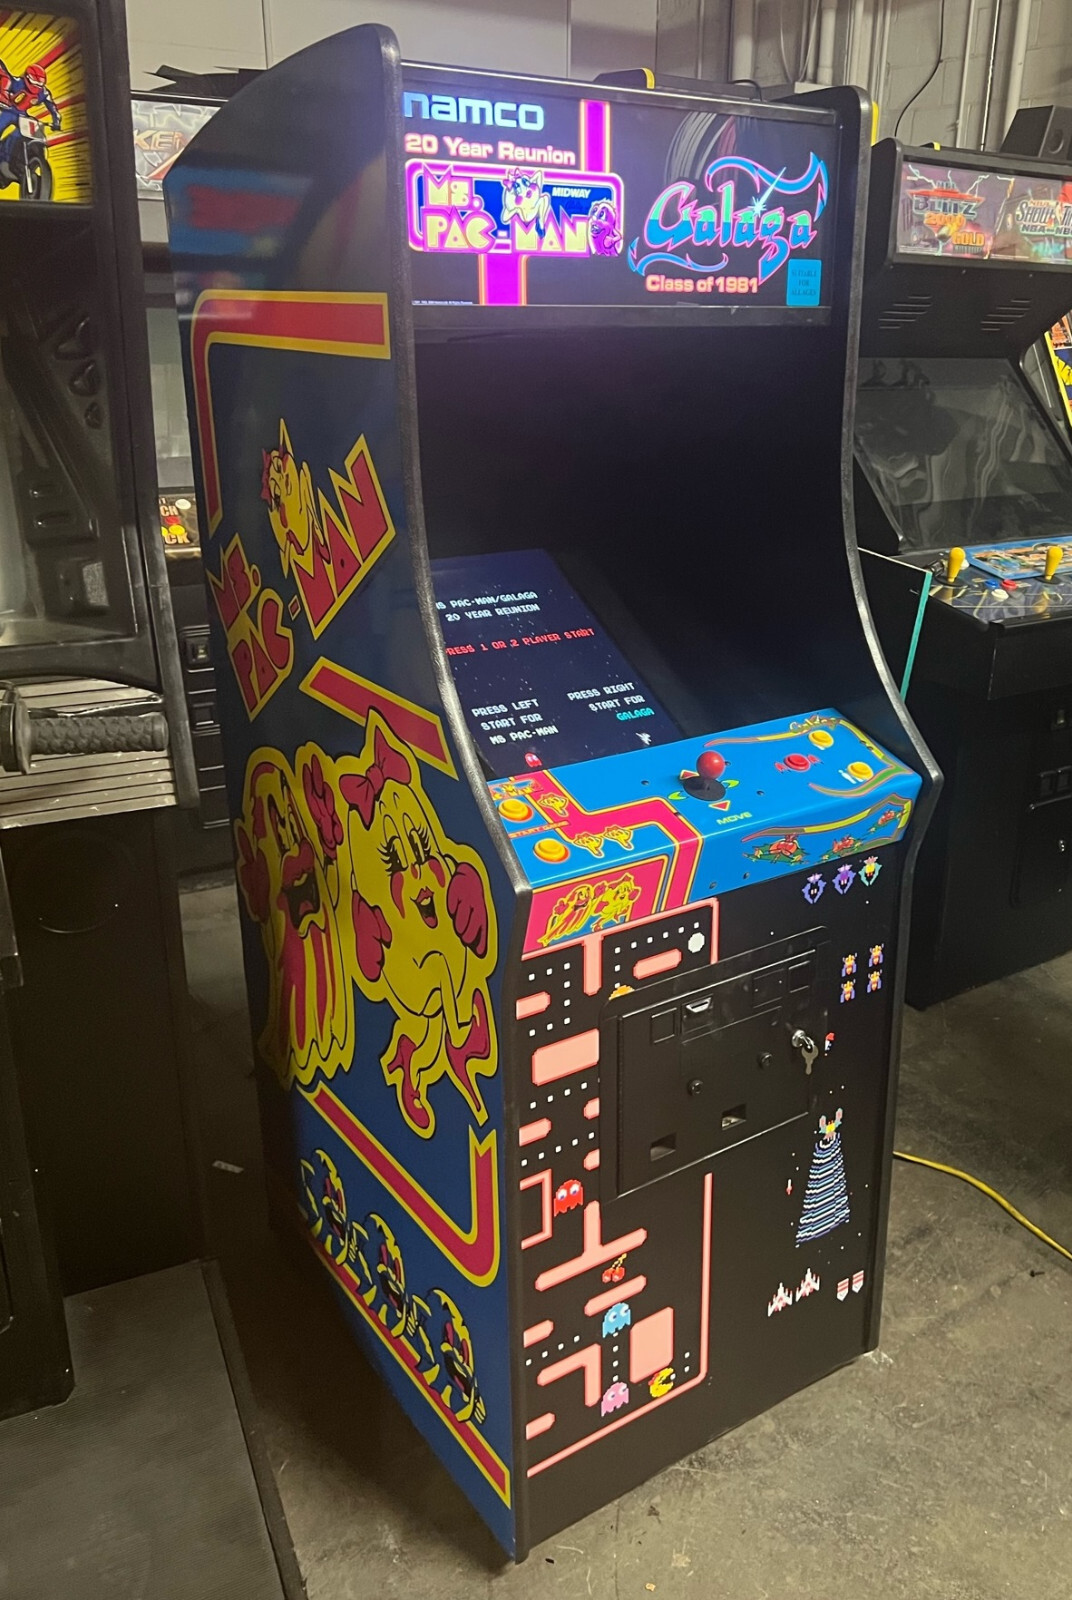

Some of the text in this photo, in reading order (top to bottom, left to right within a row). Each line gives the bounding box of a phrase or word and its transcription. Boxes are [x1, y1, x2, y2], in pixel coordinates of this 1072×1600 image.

[403, 91, 544, 131] namco
[404, 132, 576, 165] 20 Year Reunion
[551, 186, 591, 199] MIDWAY
[423, 207, 589, 256] PAC-MAN
[644, 180, 818, 286] Galaga
[645, 274, 758, 294] Class of 1981
[445, 603, 541, 622] 20 YEAR REUNION
[480, 643, 489, 651] 1
[491, 640, 508, 650] OR
[510, 639, 520, 648] 2
[522, 632, 562, 646] PLAYER
[563, 628, 596, 640] START
[566, 682, 635, 701] PRESS RIGHT
[471, 698, 540, 718] PRESS LEFT
[588, 694, 646, 712] START FOR
[480, 713, 544, 731] START FOR
[615, 707, 656, 721] GALAGA
[489, 725, 560, 745] MS PAC-MAN
[716, 811, 753, 825] MOVE
